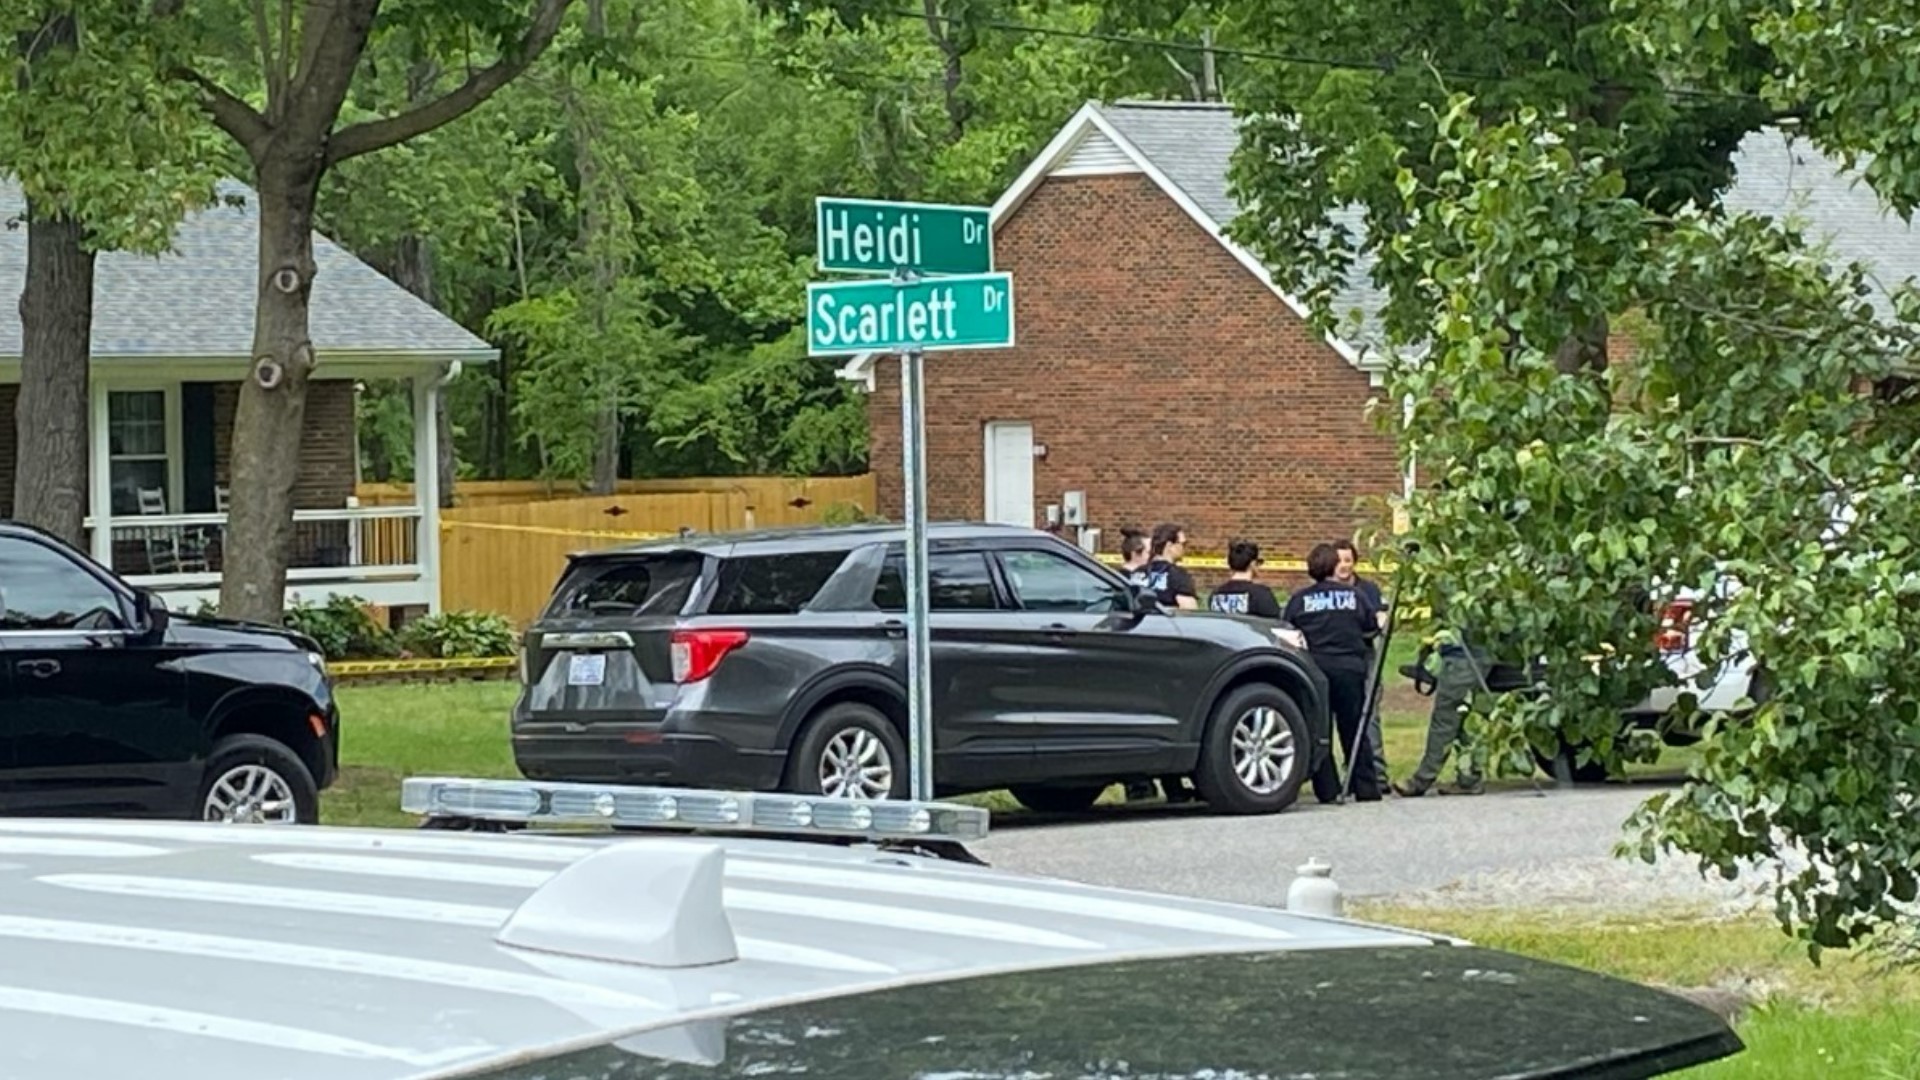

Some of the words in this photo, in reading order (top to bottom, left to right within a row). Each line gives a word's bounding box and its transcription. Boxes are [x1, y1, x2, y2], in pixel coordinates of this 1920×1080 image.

[825, 209, 921, 265] Heidi
[962, 216, 984, 244] Dr
[815, 287, 957, 345] Scarlett
[983, 285, 1005, 312] Dr
